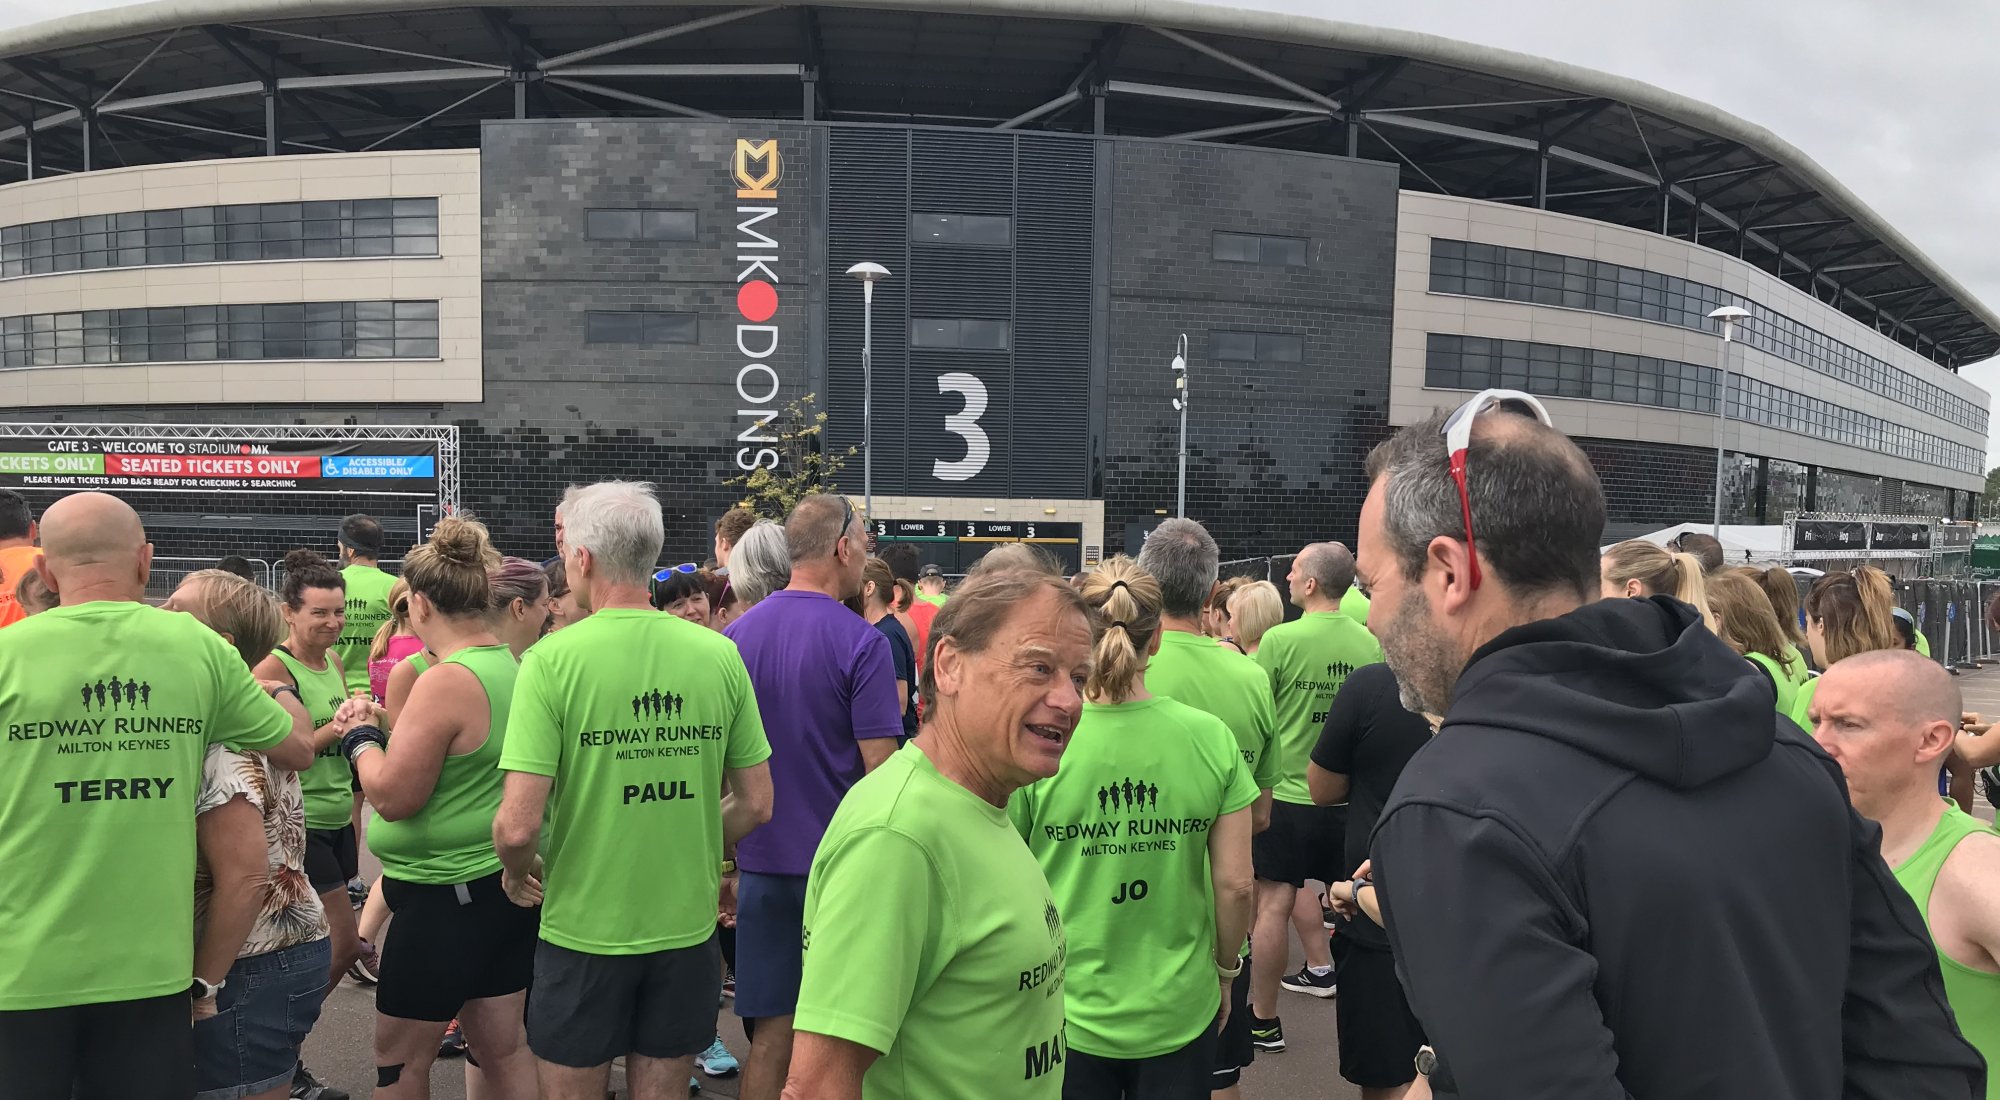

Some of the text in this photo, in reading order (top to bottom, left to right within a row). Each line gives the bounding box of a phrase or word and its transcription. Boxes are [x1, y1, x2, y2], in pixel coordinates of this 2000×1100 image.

[736, 324, 780, 472] DONS
[932, 372, 991, 481] 3
[48, 441, 78, 452] GATE
[82, 442, 89, 452] 3
[101, 441, 165, 454] WELCOME
[168, 443, 185, 454] TO
[54, 457, 96, 471] ONLY
[121, 458, 300, 474] SEATED TICKETS ONLY
[342, 467, 414, 476] DISABLED ONLY
[23, 476, 52, 484] PLEASE
[54, 476, 75, 484] HAVE
[78, 477, 109, 485] TICKETS
[111, 477, 128, 486] AND
[131, 477, 152, 486] BAGS
[153, 478, 179, 487] READY
[181, 478, 197, 487] FOR
[199, 479, 240, 488] CHECKING
[251, 479, 296, 488] SEARCHING
[877, 524, 886, 535] 3
[900, 523, 946, 536] LOWER 3
[966, 525, 975, 536] 3
[1026, 527, 1035, 538] 3
[335, 636, 373, 646] ATTHE
[1296, 681, 1335, 691] REDWAY
[8, 716, 203, 741] REDWAY RUNNERS
[580, 728, 650, 747] REDWAY
[57, 739, 170, 754] MILTON KEYNES
[616, 745, 700, 760] MILTON KEYNES
[54, 777, 174, 803] TERRY
[623, 780, 695, 805] PAUL
[1045, 817, 1211, 842] REDWAY RUNNERS
[1081, 840, 1176, 857] MILTON KEYNES
[1112, 879, 1148, 905] JO
